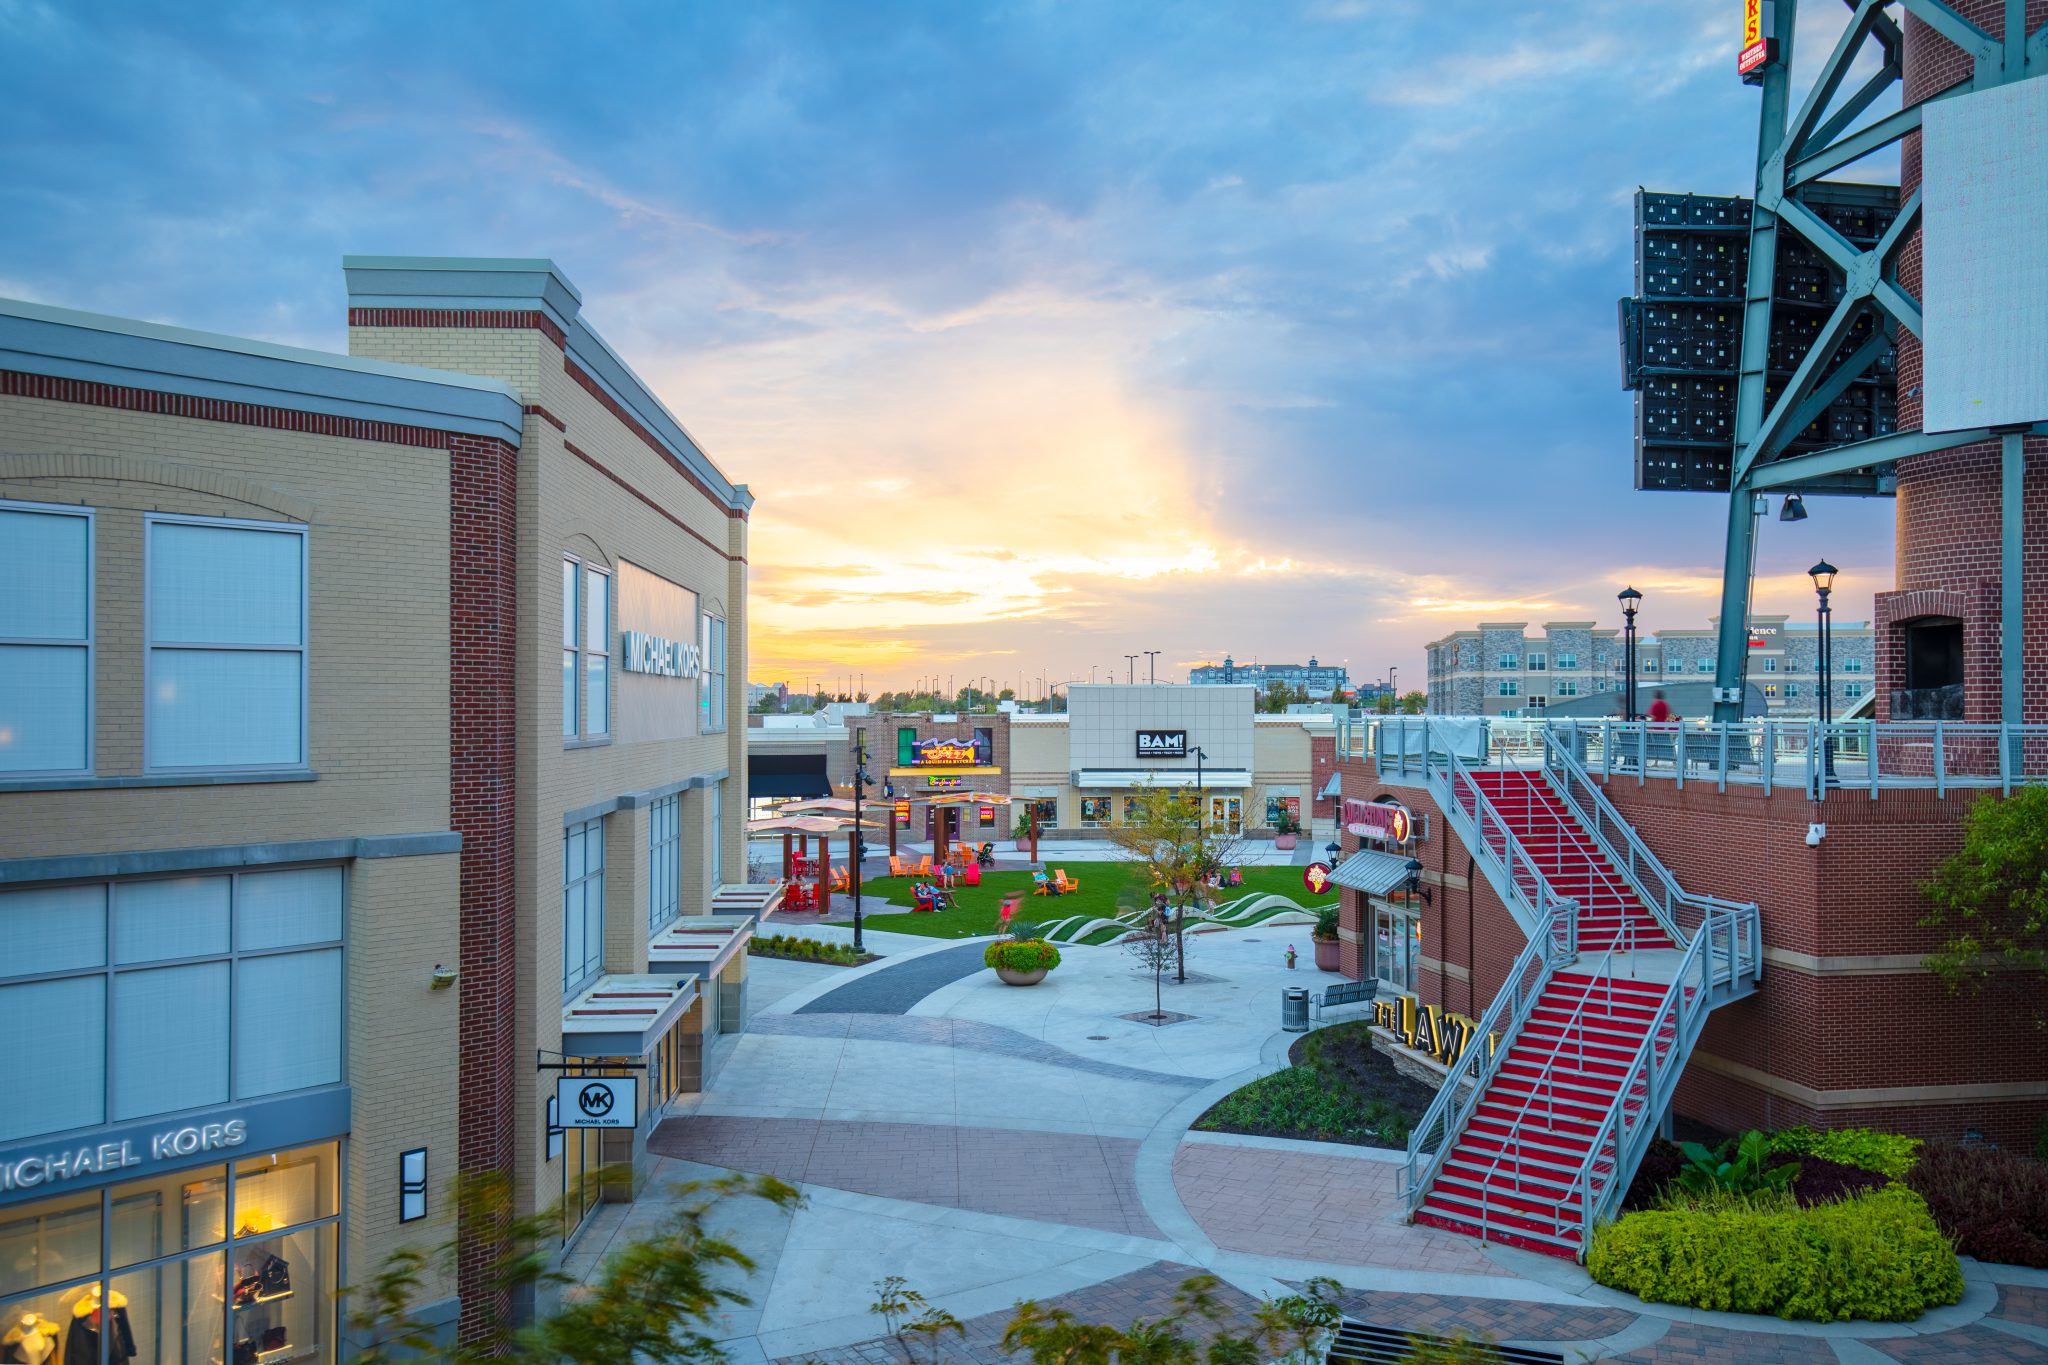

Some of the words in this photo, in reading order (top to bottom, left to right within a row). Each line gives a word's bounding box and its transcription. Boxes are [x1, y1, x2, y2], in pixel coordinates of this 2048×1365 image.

[629, 631, 675, 676] MICHAEL
[677, 641, 700, 679] KORS
[1139, 734, 1184, 748] BAM!
[1371, 1003, 1396, 1032] THE
[0, 1140, 141, 1192] ICHAEL
[152, 1119, 247, 1160] KORS
